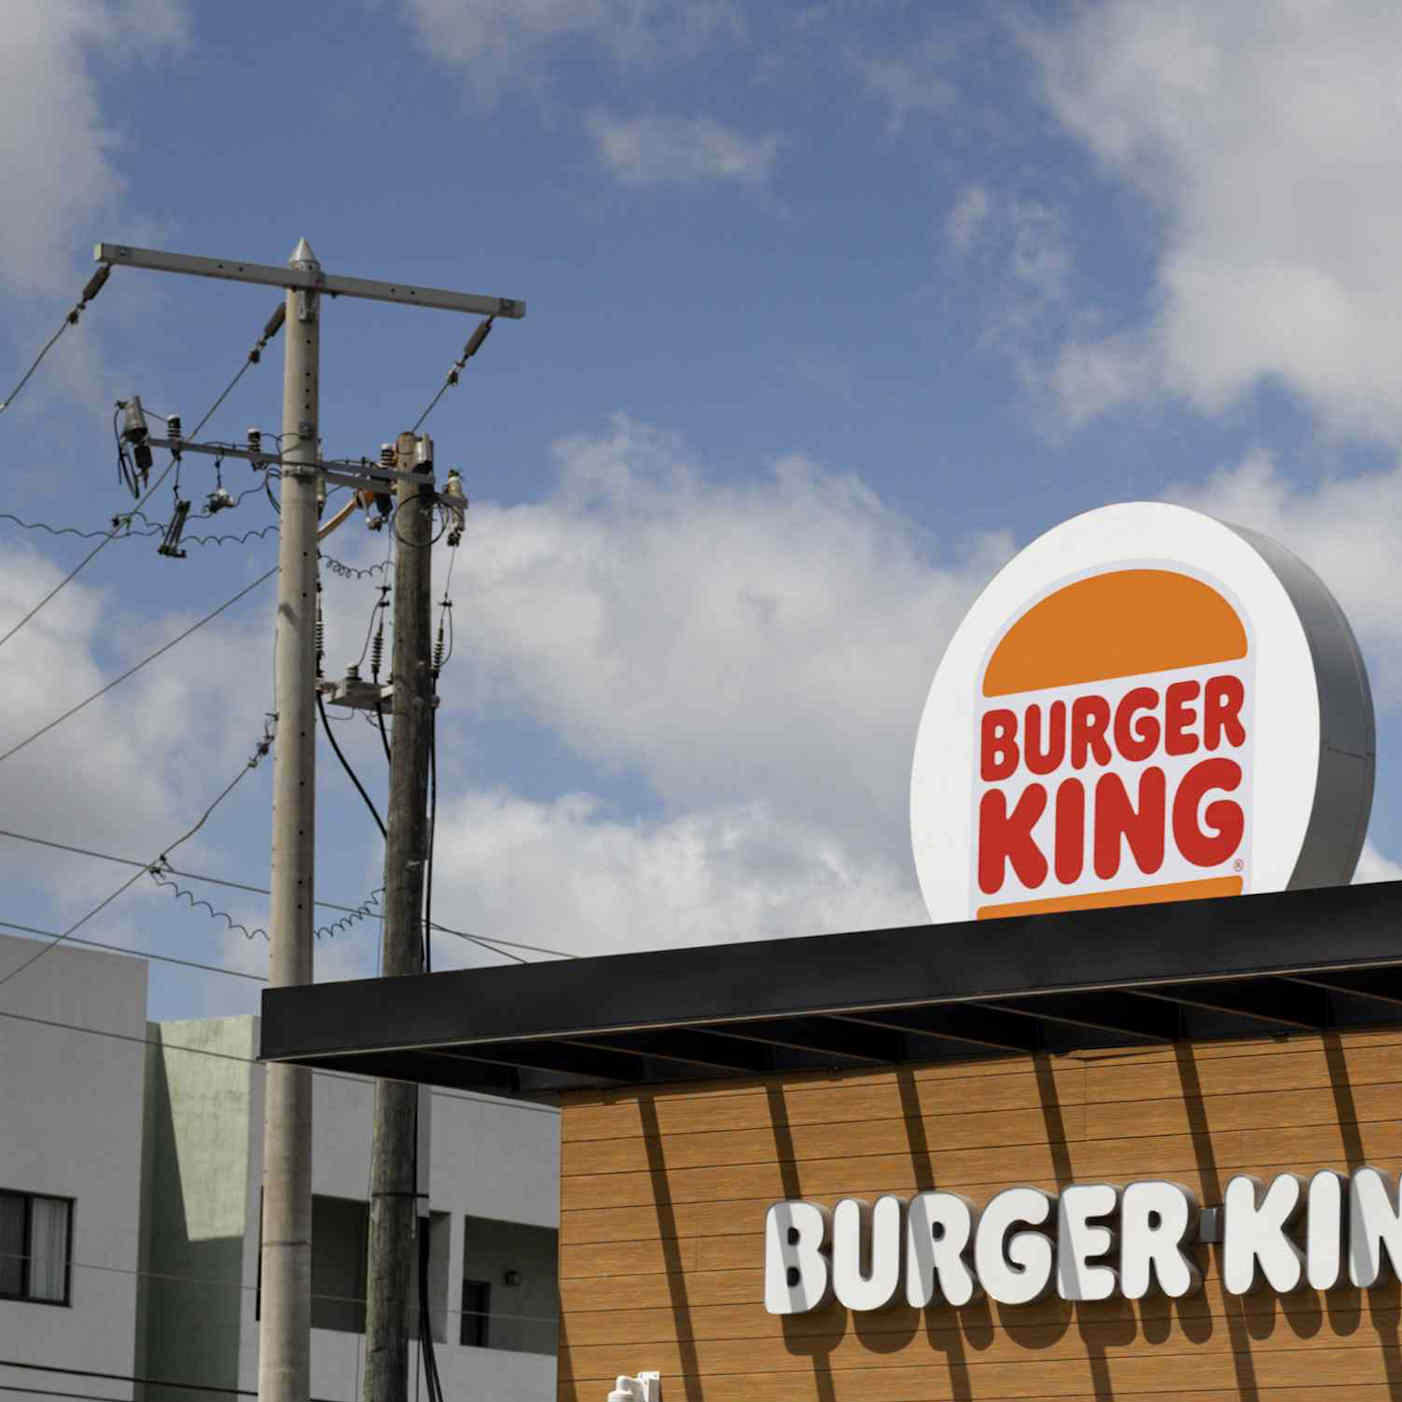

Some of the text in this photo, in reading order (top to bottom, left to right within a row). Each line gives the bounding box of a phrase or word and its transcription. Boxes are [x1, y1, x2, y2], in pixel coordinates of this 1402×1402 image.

[980, 674, 1246, 782] BURGER
[978, 757, 1244, 895] KING
[765, 1178, 1196, 1314] BURGER
